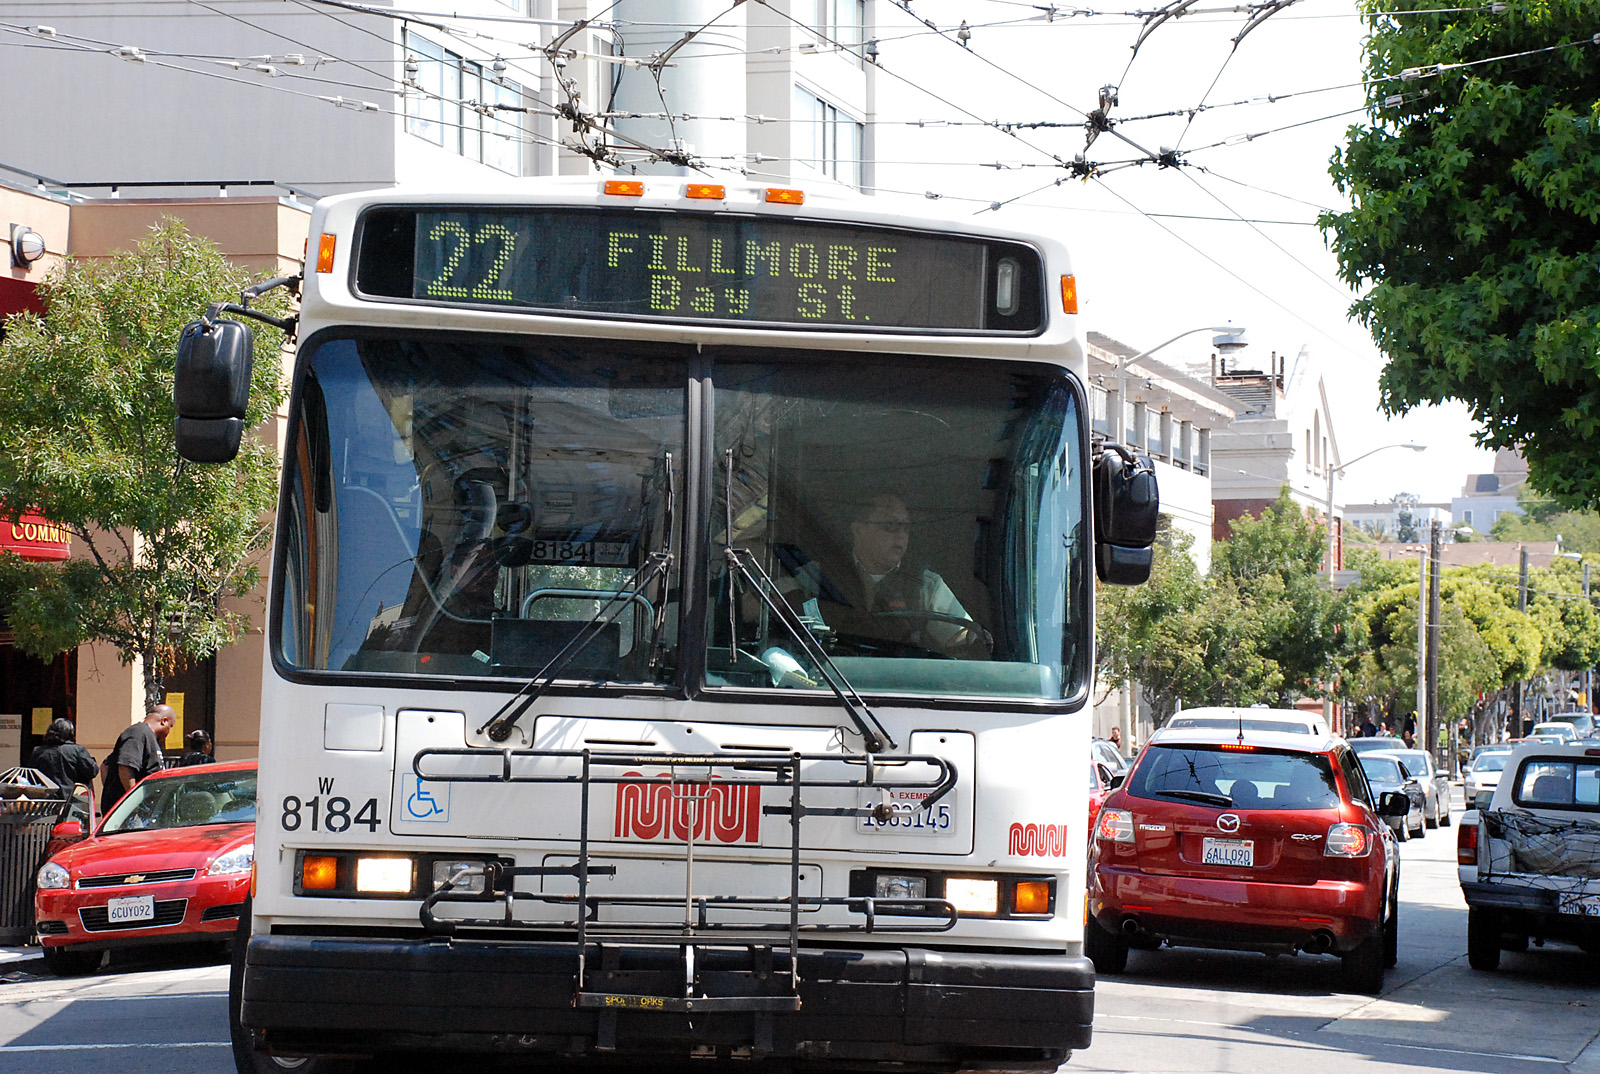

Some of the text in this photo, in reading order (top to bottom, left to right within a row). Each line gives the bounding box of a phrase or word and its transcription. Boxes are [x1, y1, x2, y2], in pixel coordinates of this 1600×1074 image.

[427, 220, 517, 301] 22
[608, 231, 897, 283] FILLMORE
[650, 274, 871, 321] Bay St.
[533, 541, 588, 560] 8184
[318, 776, 335, 795] W
[899, 791, 933, 800] EXEMP
[281, 795, 382, 833] 8184
[111, 904, 151, 919] 6CUY092
